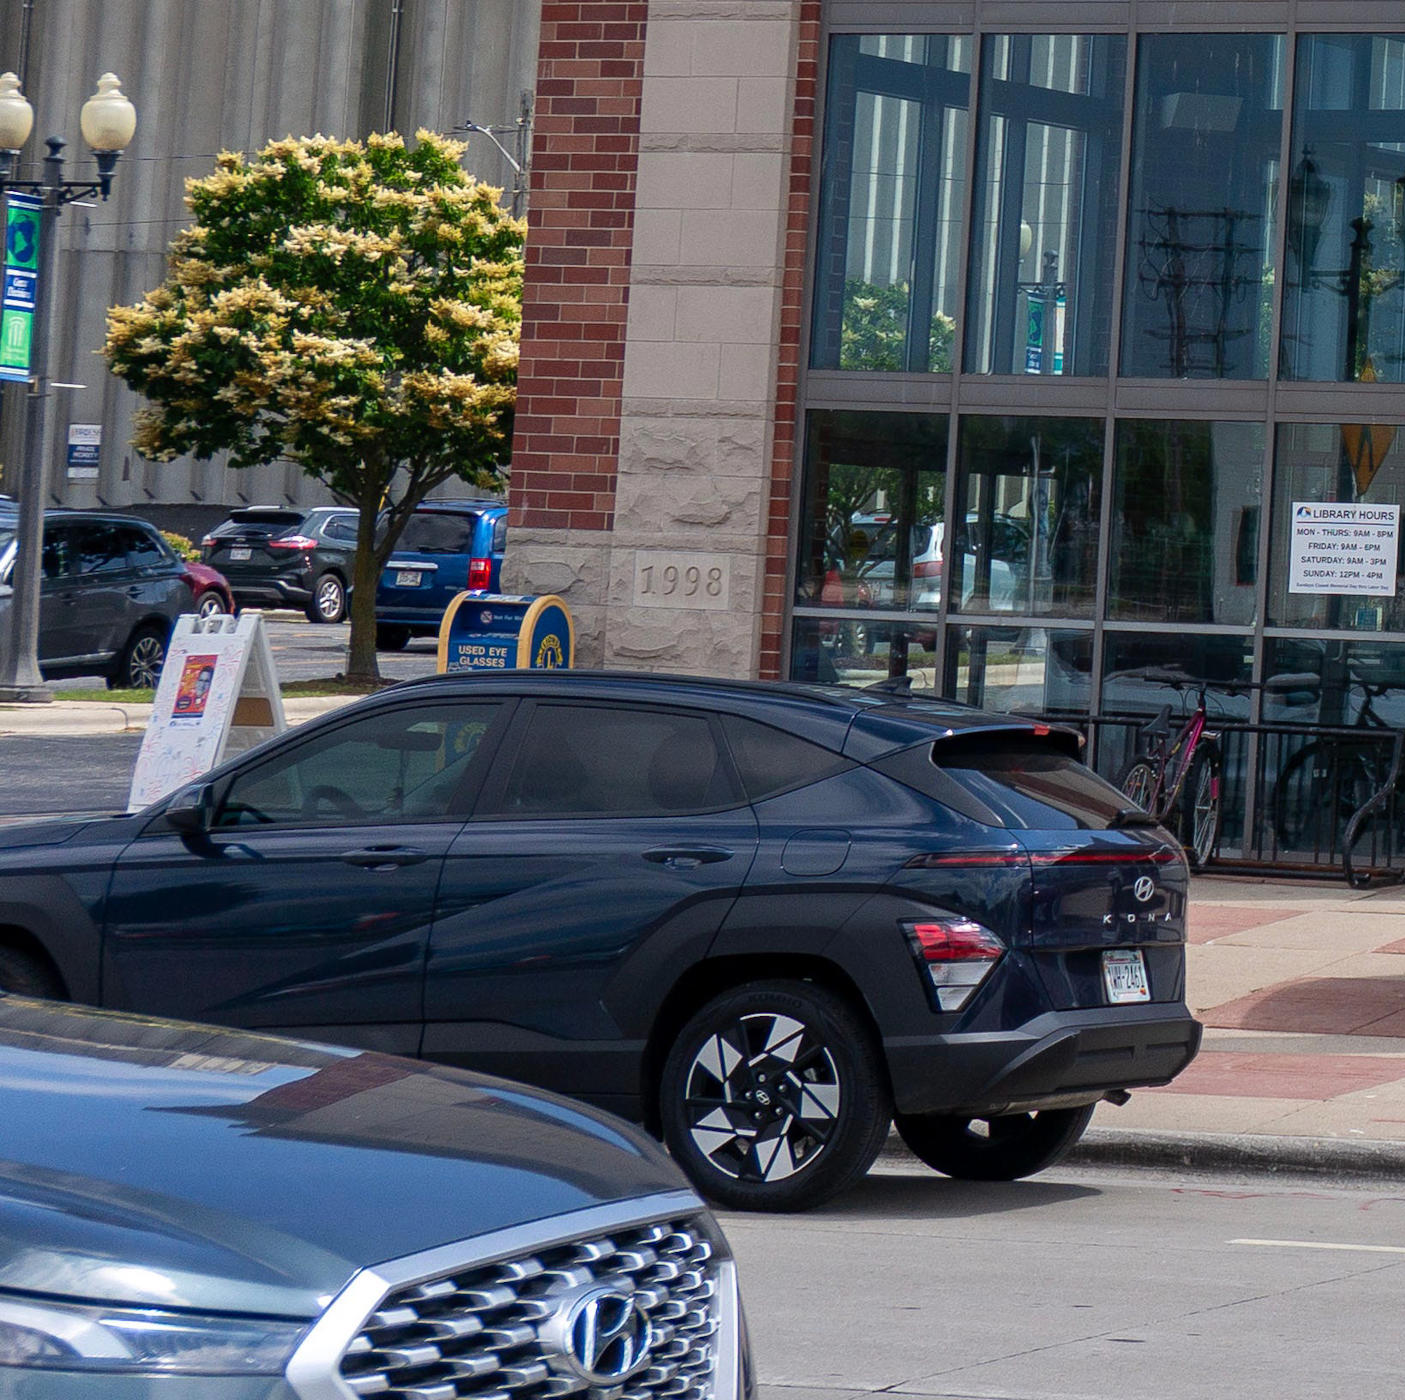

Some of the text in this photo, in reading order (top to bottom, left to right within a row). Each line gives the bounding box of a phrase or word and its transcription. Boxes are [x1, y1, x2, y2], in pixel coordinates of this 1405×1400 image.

[1313, 509, 1395, 520] LIBRARY HOURS
[1296, 528, 1316, 536] MON
[1322, 529, 1352, 537] THURS:
[1353, 529, 1370, 537] 9AM
[1308, 542, 1339, 550] FRIDAY:
[1340, 543, 1357, 551] 9AM
[1301, 556, 1345, 564] SATURDAY:
[1346, 557, 1364, 565] 9AM
[1303, 570, 1337, 578] SUNDAY:
[1340, 570, 1360, 578] 12PM
[640, 565, 722, 597] 1998
[458, 645, 508, 657] USED EYE
[460, 656, 506, 668] GLASSES
[1103, 912, 1172, 924] KONA
